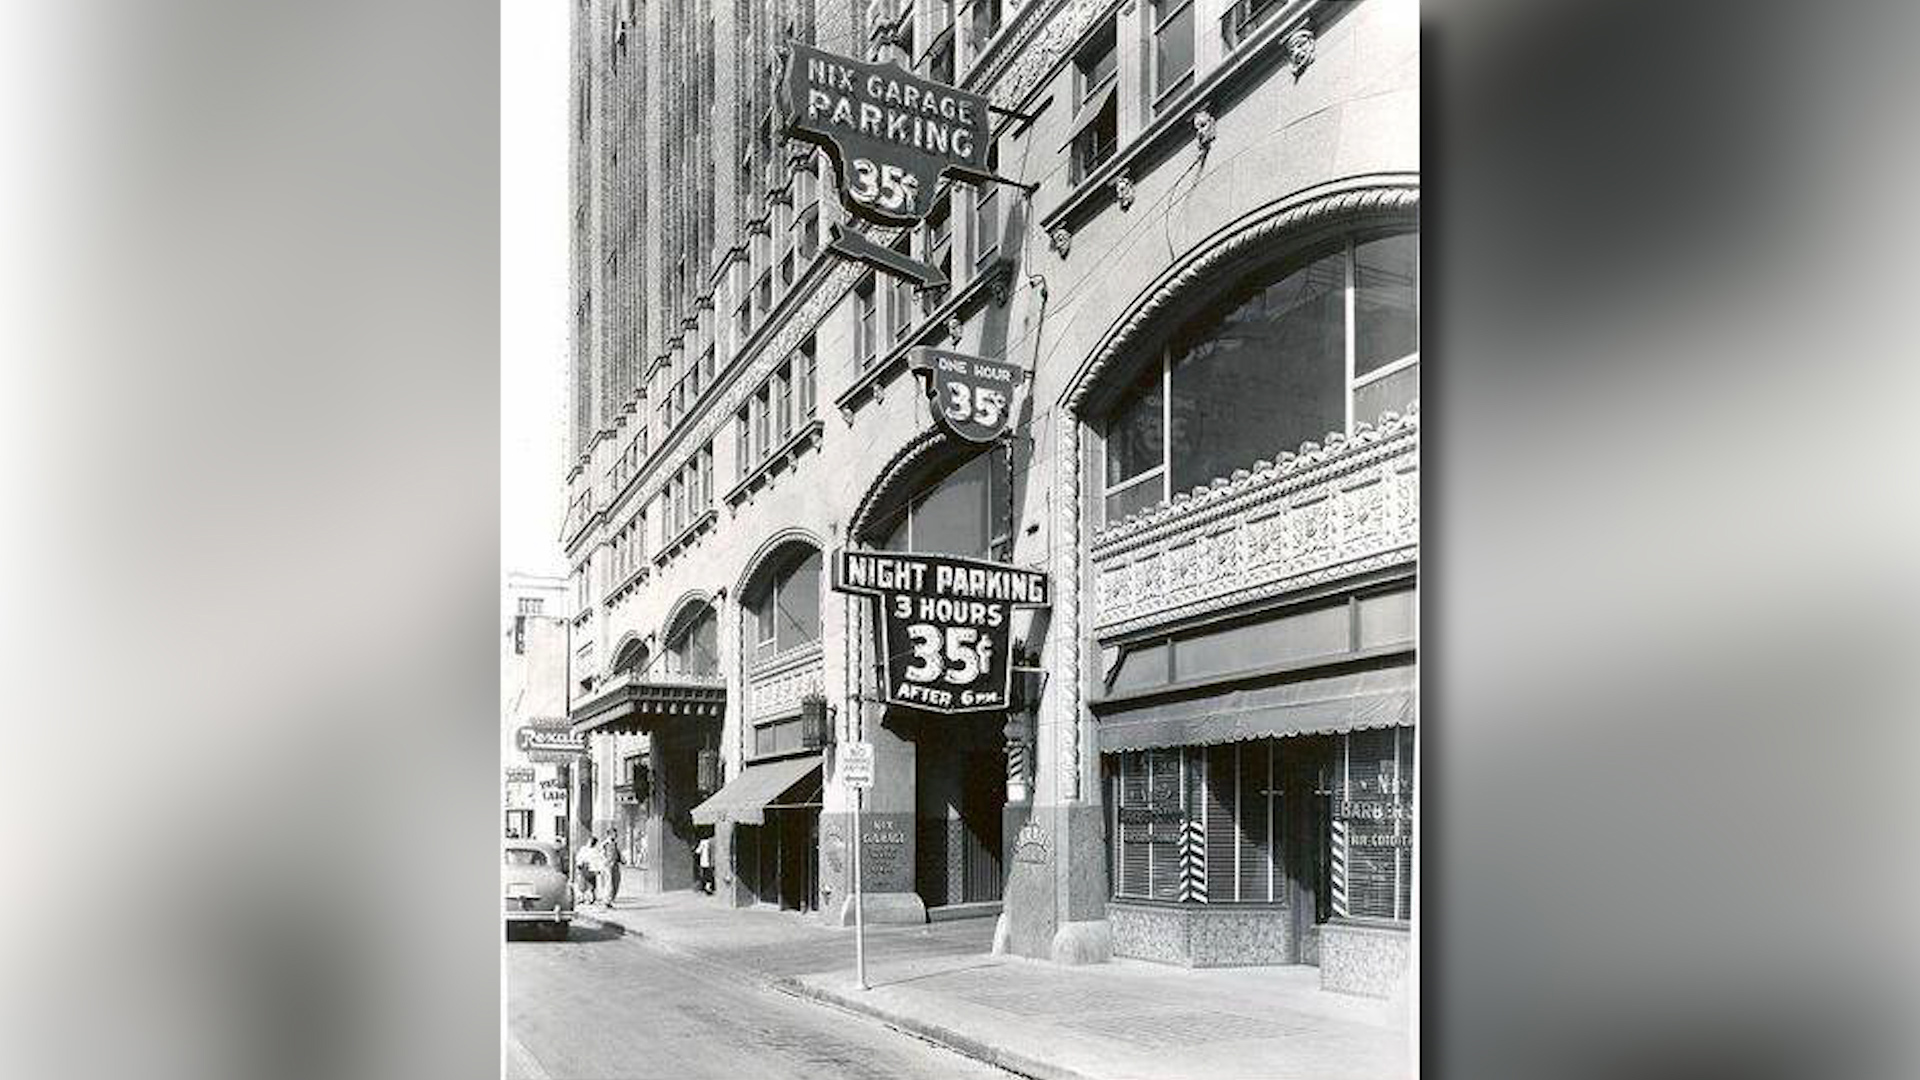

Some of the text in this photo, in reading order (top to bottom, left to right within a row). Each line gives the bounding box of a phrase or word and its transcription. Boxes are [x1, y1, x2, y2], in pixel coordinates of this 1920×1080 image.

[807, 58, 974, 126] NIX GARAGE
[808, 88, 974, 158] PARKING
[938, 357, 1011, 382] ONE HOUR
[848, 554, 1045, 603] NIGHT PARKING
[894, 594, 1003, 627] 3 HOURS
[905, 623, 993, 684] 35¢
[898, 682, 952, 706] AFTER
